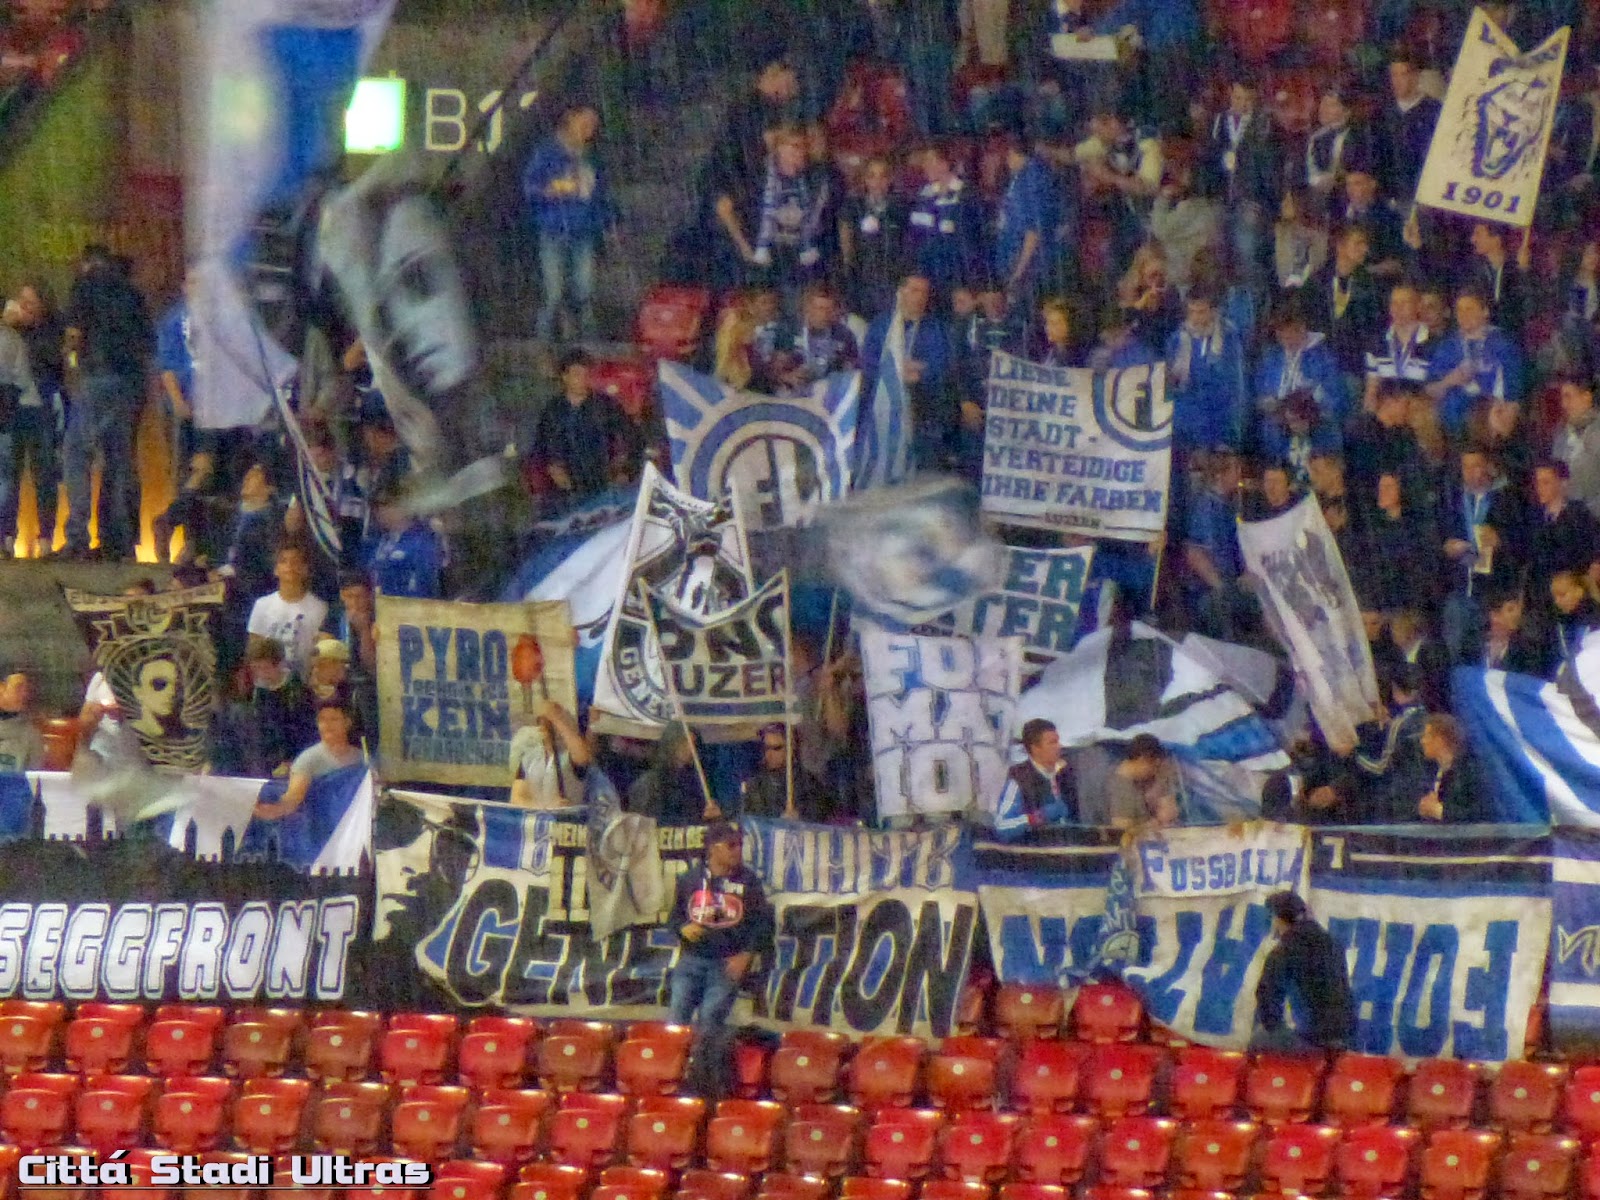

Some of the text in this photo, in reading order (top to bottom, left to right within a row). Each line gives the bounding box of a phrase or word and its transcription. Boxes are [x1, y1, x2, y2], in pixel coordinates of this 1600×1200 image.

[1442, 181, 1521, 214] 1901
[990, 388, 1078, 418] DEINE
[988, 416, 1082, 449] STADT
[986, 446, 1147, 483] VERTEIDIGE
[982, 474, 1162, 513] IHRE FARBEN
[398, 624, 508, 690] PYRO
[403, 697, 512, 741] KEIN
